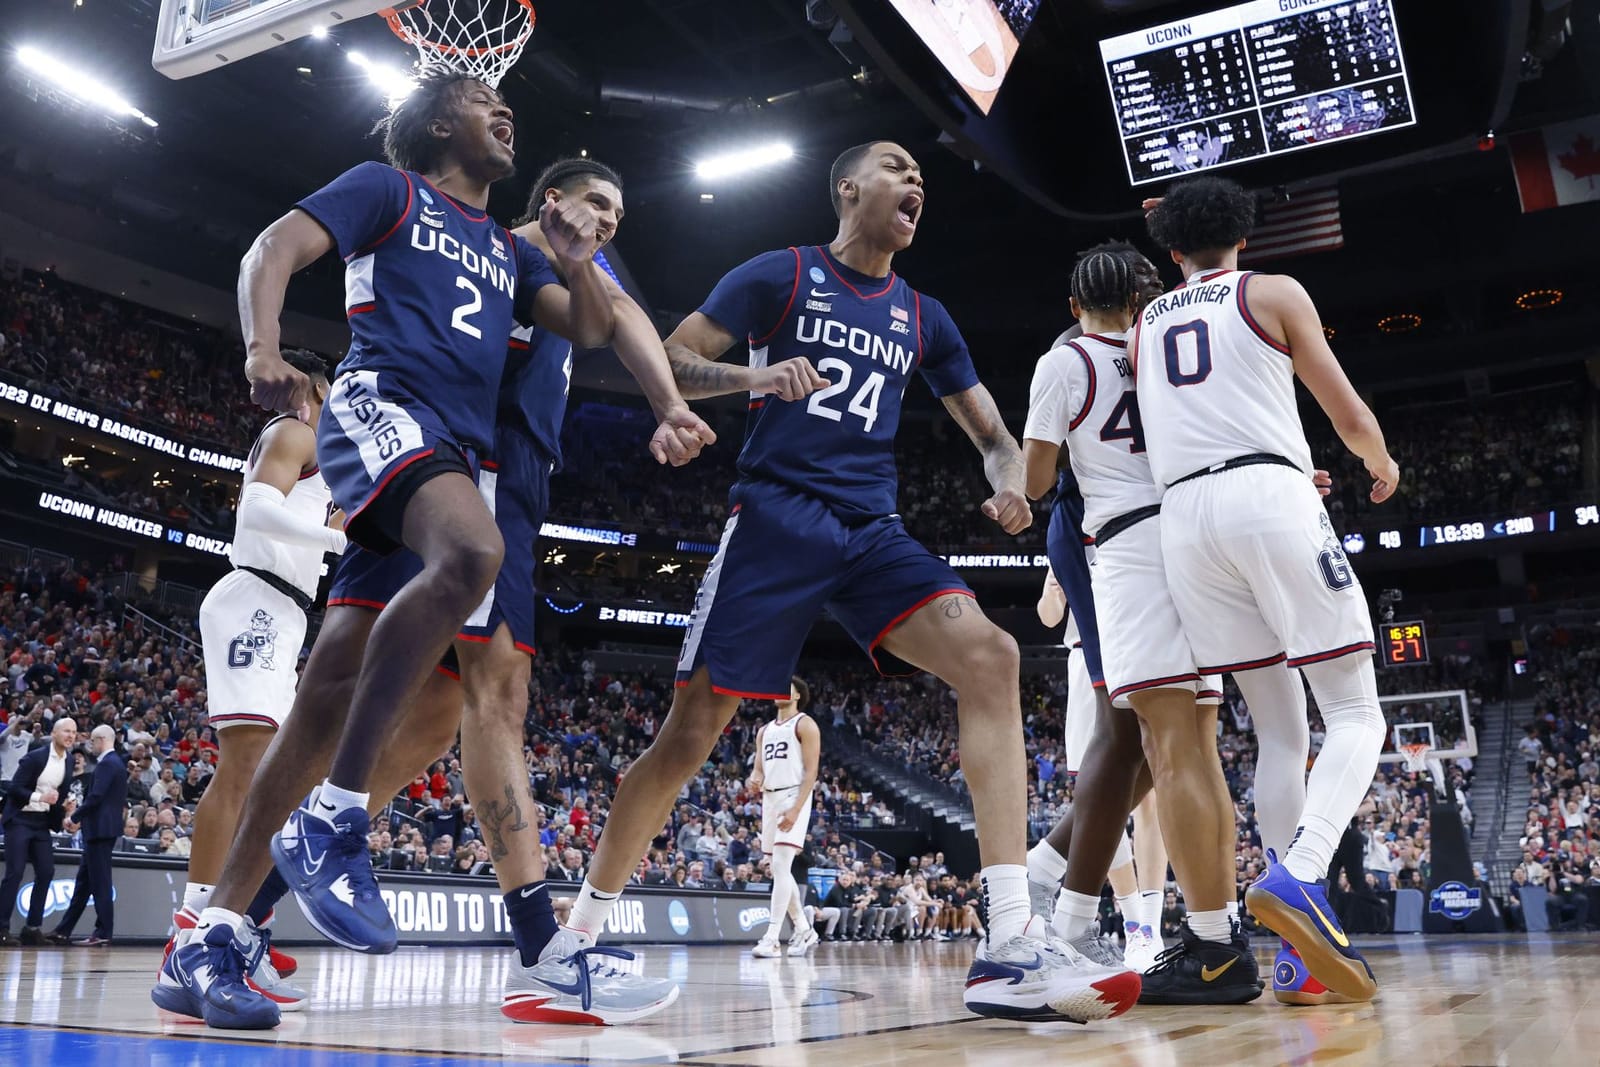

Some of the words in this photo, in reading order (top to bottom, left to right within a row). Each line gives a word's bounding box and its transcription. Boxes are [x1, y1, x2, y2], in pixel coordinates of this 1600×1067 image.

[1146, 23, 1192, 46] UCONN
[411, 223, 514, 300] UCONN
[451, 275, 482, 340] 2
[1145, 284, 1231, 326] STRAWTHER
[796, 315, 914, 376] UCONN
[1163, 318, 1212, 388] 0
[806, 357, 886, 433] 24
[30, 393, 52, 412] DI
[52, 401, 101, 428] MEN'S
[100, 417, 186, 459] BASKETBALL
[341, 373, 402, 462] HUSKIES
[39, 492, 95, 520] UCONN
[96, 508, 163, 538] HUSKIES
[167, 529, 184, 544] VS
[1379, 531, 1401, 548] 49
[1433, 522, 1485, 544] 16:39
[1505, 517, 1534, 535] 2ND
[1575, 506, 1600, 526] 34
[949, 555, 1030, 567] BASKETBALL
[1317, 549, 1354, 592] G
[617, 609, 664, 625] SWEET
[665, 612, 690, 627] SIX
[1390, 626, 1421, 640] 16:39
[228, 637, 256, 669] G
[1391, 638, 1421, 662] 27
[764, 742, 788, 760] 22
[380, 889, 448, 932] ROAD
[453, 893, 485, 932] TO
[600, 900, 647, 934] OUR
